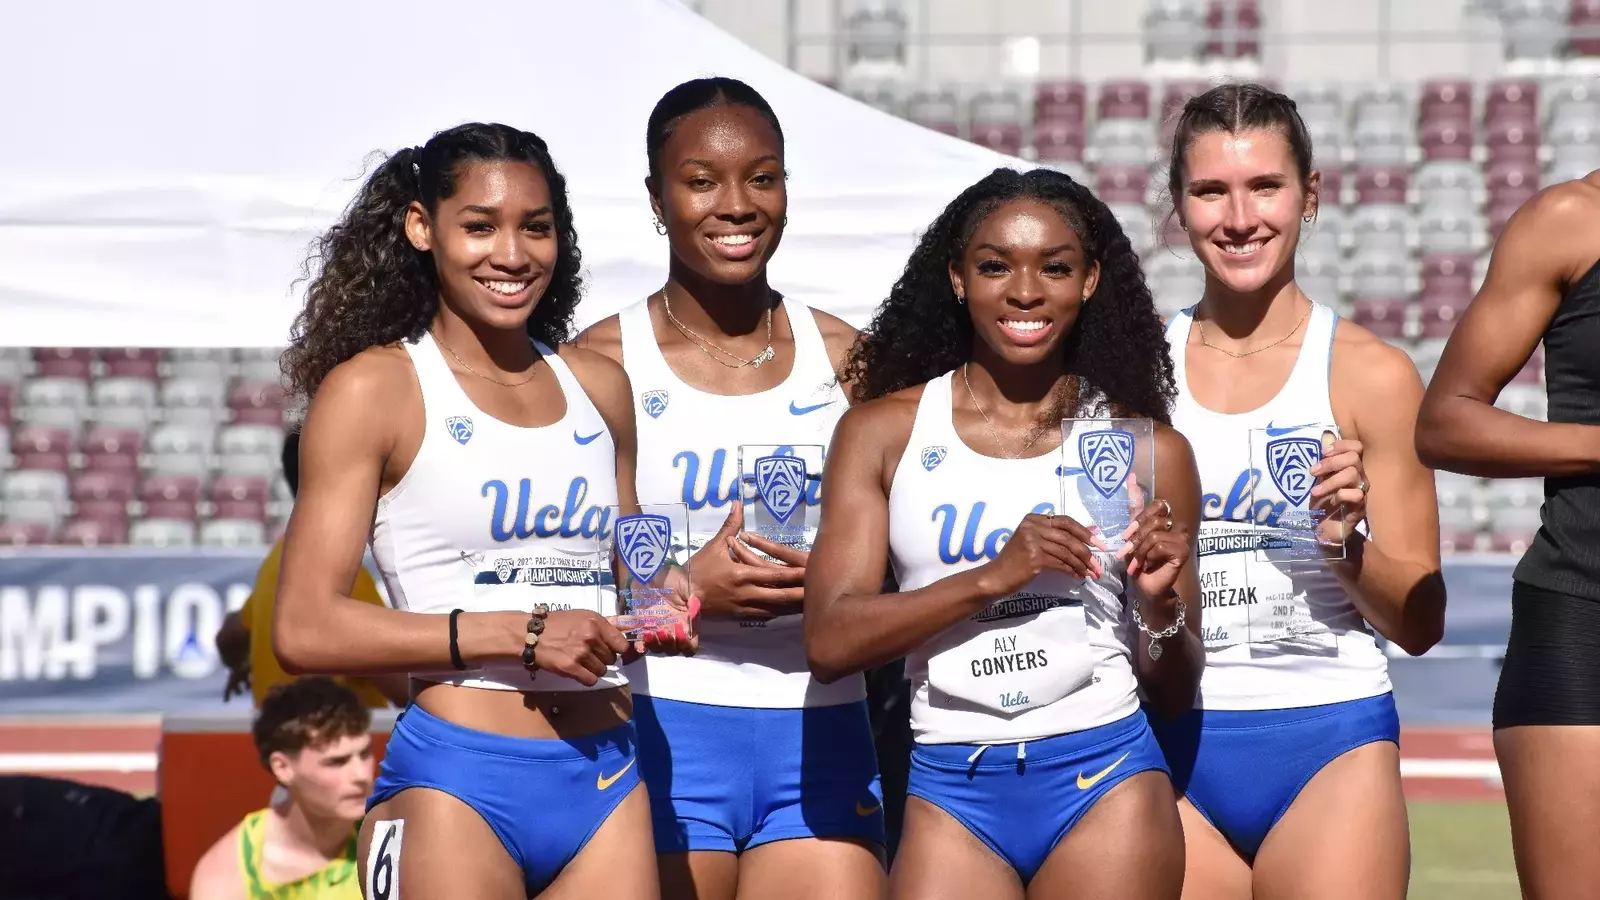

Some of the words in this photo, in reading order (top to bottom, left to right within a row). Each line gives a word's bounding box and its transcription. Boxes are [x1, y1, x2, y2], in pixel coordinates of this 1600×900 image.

[642, 391, 668, 408] PAC
[649, 403, 663, 415] 12
[446, 416, 473, 434] PAC
[455, 427, 470, 441] 12
[921, 446, 948, 461] PAC
[1084, 435, 1130, 470] PAC
[1270, 441, 1320, 475] PAC
[924, 456, 938, 469] 12
[758, 457, 803, 490] PAC
[1098, 465, 1118, 482] 12
[1286, 473, 1306, 491] 12
[773, 490, 790, 507] 12
[481, 476, 612, 542] Ucla
[620, 520, 667, 554] PAC
[635, 551, 654, 569] 12
[994, 635, 1017, 654] ALY
[971, 649, 1048, 678] CONYERS
[1000, 690, 1030, 709] Ucla
[373, 824, 397, 900] 6
